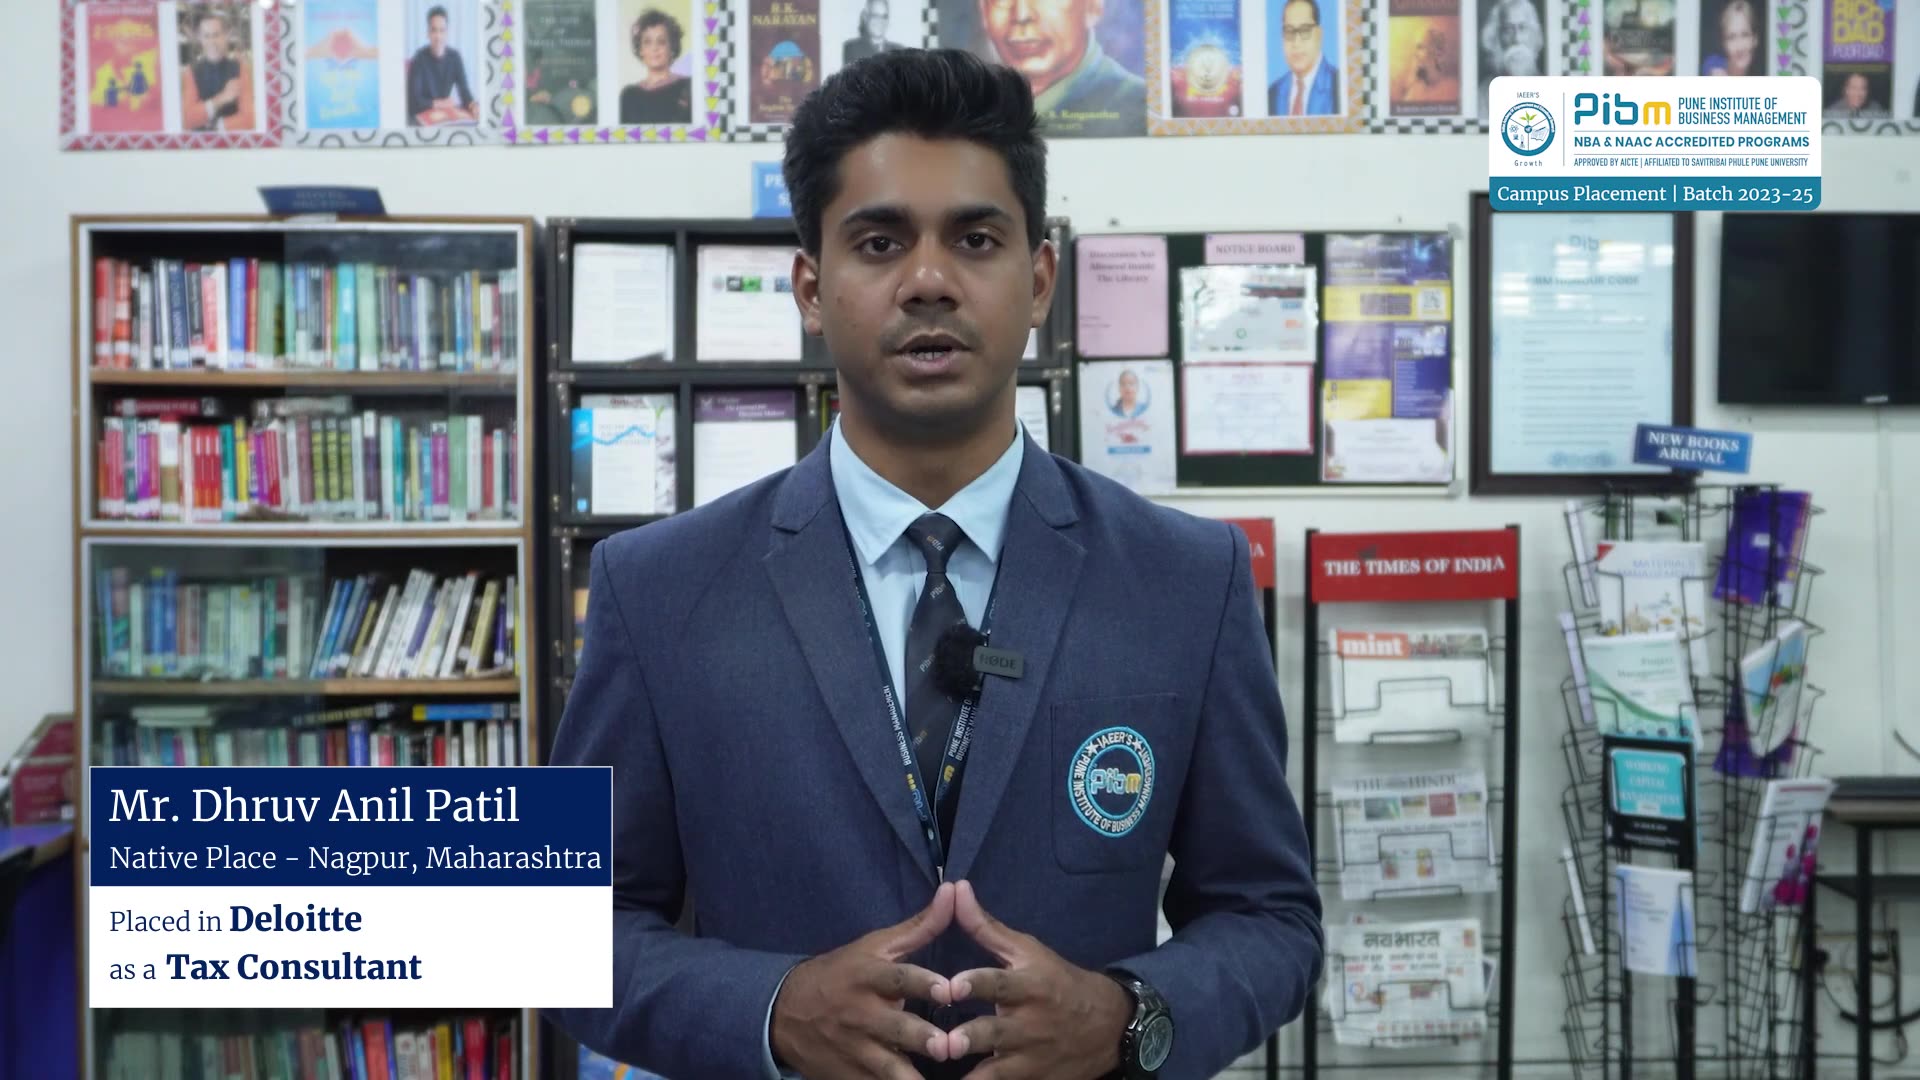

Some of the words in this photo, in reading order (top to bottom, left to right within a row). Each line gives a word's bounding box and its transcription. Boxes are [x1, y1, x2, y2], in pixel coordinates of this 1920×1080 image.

[752, 15, 816, 25] NARAYAN
[1832, 20, 1886, 44] DAD
[1215, 244, 1253, 255] NOTICE
[1257, 243, 1296, 255] BOARD
[1648, 431, 1684, 447] NEW
[1687, 434, 1740, 452] BOOKS
[1658, 447, 1725, 465] ARRIVAL
[1324, 559, 1360, 576] THE
[1365, 558, 1420, 575] TIMES
[1424, 557, 1450, 574] OF
[1454, 556, 1505, 573] INDIA
[1342, 632, 1403, 657] mint
[953, 706, 971, 738] INSTITUTE
[948, 737, 960, 758] PUNE
[1096, 731, 1133, 748] IAEER'S
[1074, 754, 1091, 779] PUNE
[1090, 767, 1142, 795] Pibm
[1073, 780, 1103, 825] INSTITUTE
[1100, 818, 1112, 831] OF
[1111, 809, 1141, 832] BUSINESS
